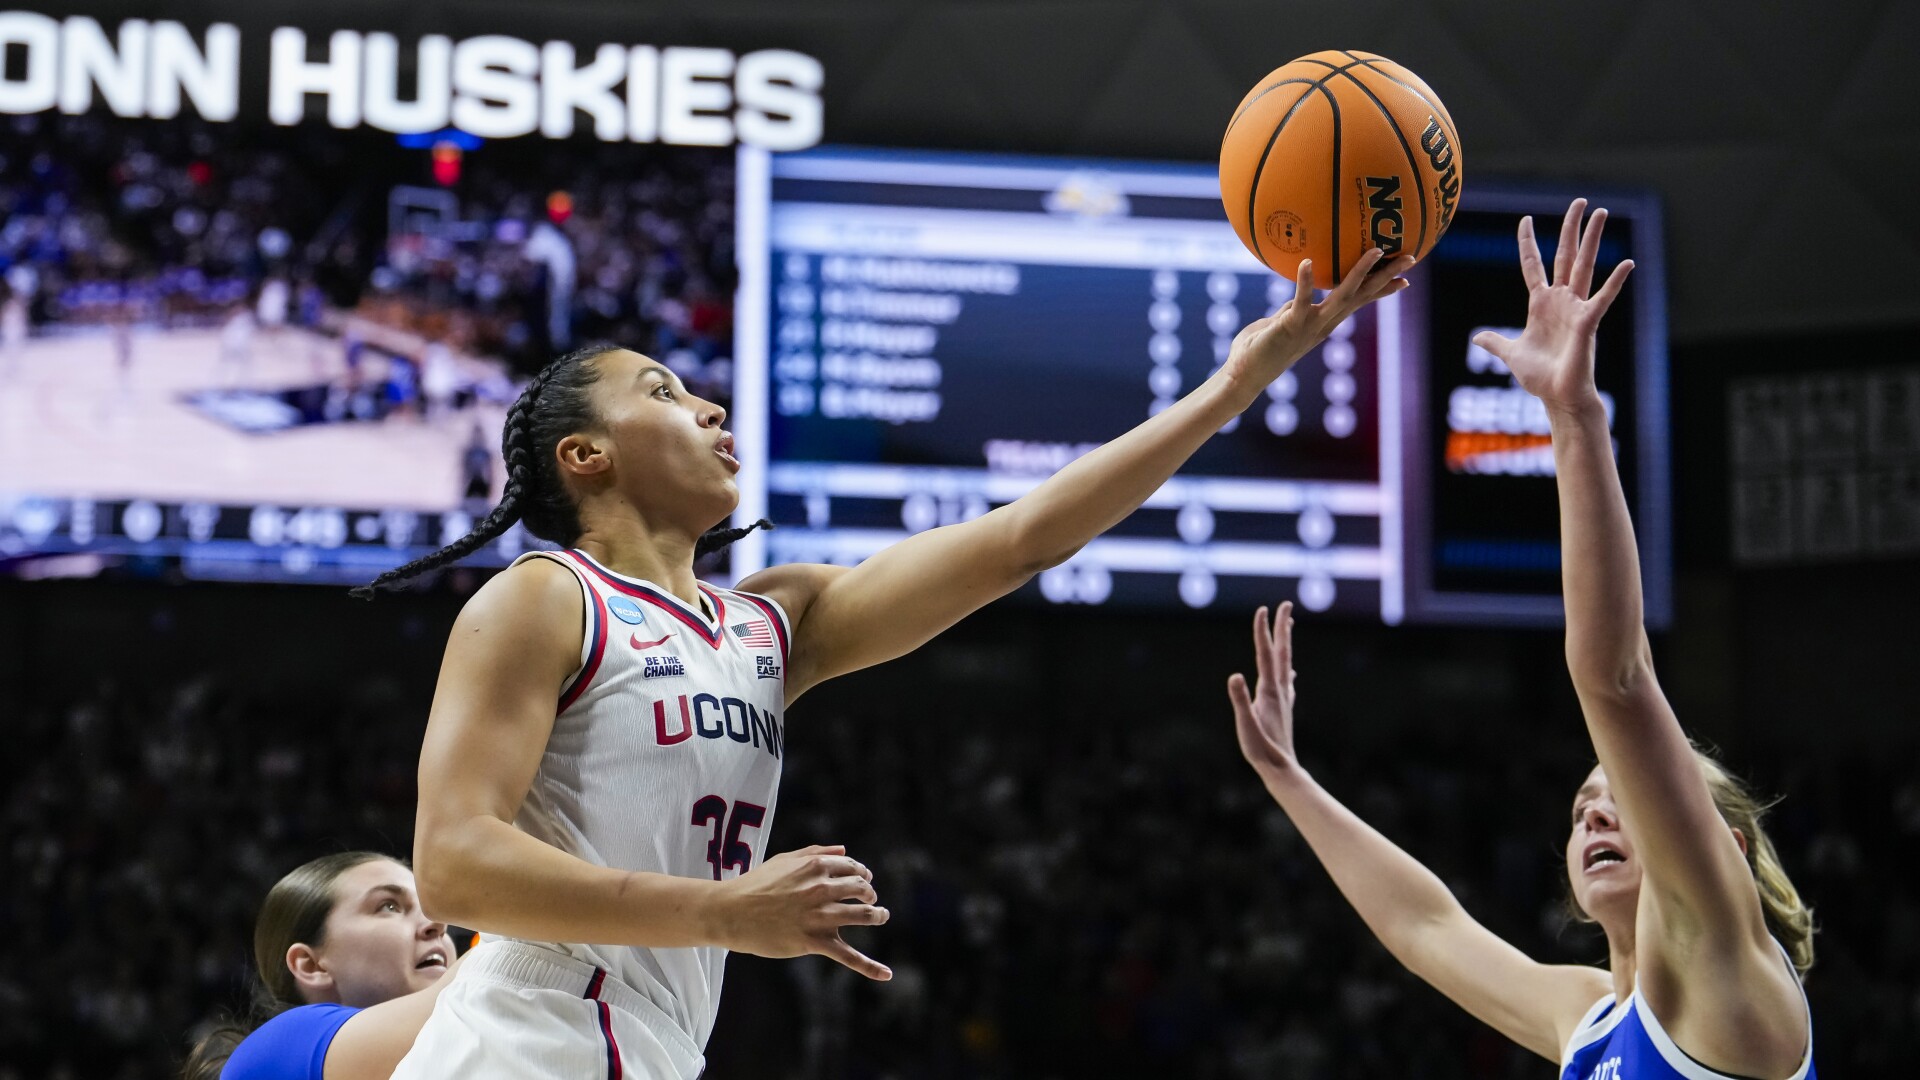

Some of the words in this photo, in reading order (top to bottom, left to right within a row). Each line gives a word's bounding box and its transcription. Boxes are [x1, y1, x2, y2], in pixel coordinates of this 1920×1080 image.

[268, 26, 825, 152] HUSKIES
[1355, 178, 1367, 227] OFFICIAL
[1365, 175, 1405, 266] NCA
[613, 605, 643, 619] NCAA
[643, 664, 685, 678] CHANGE
[645, 656, 661, 666] BE
[662, 655, 681, 665] THE
[756, 655, 774, 665] BIG
[756, 666, 781, 676] EAST
[653, 692, 784, 760] UCONN
[690, 794, 767, 882] 35
